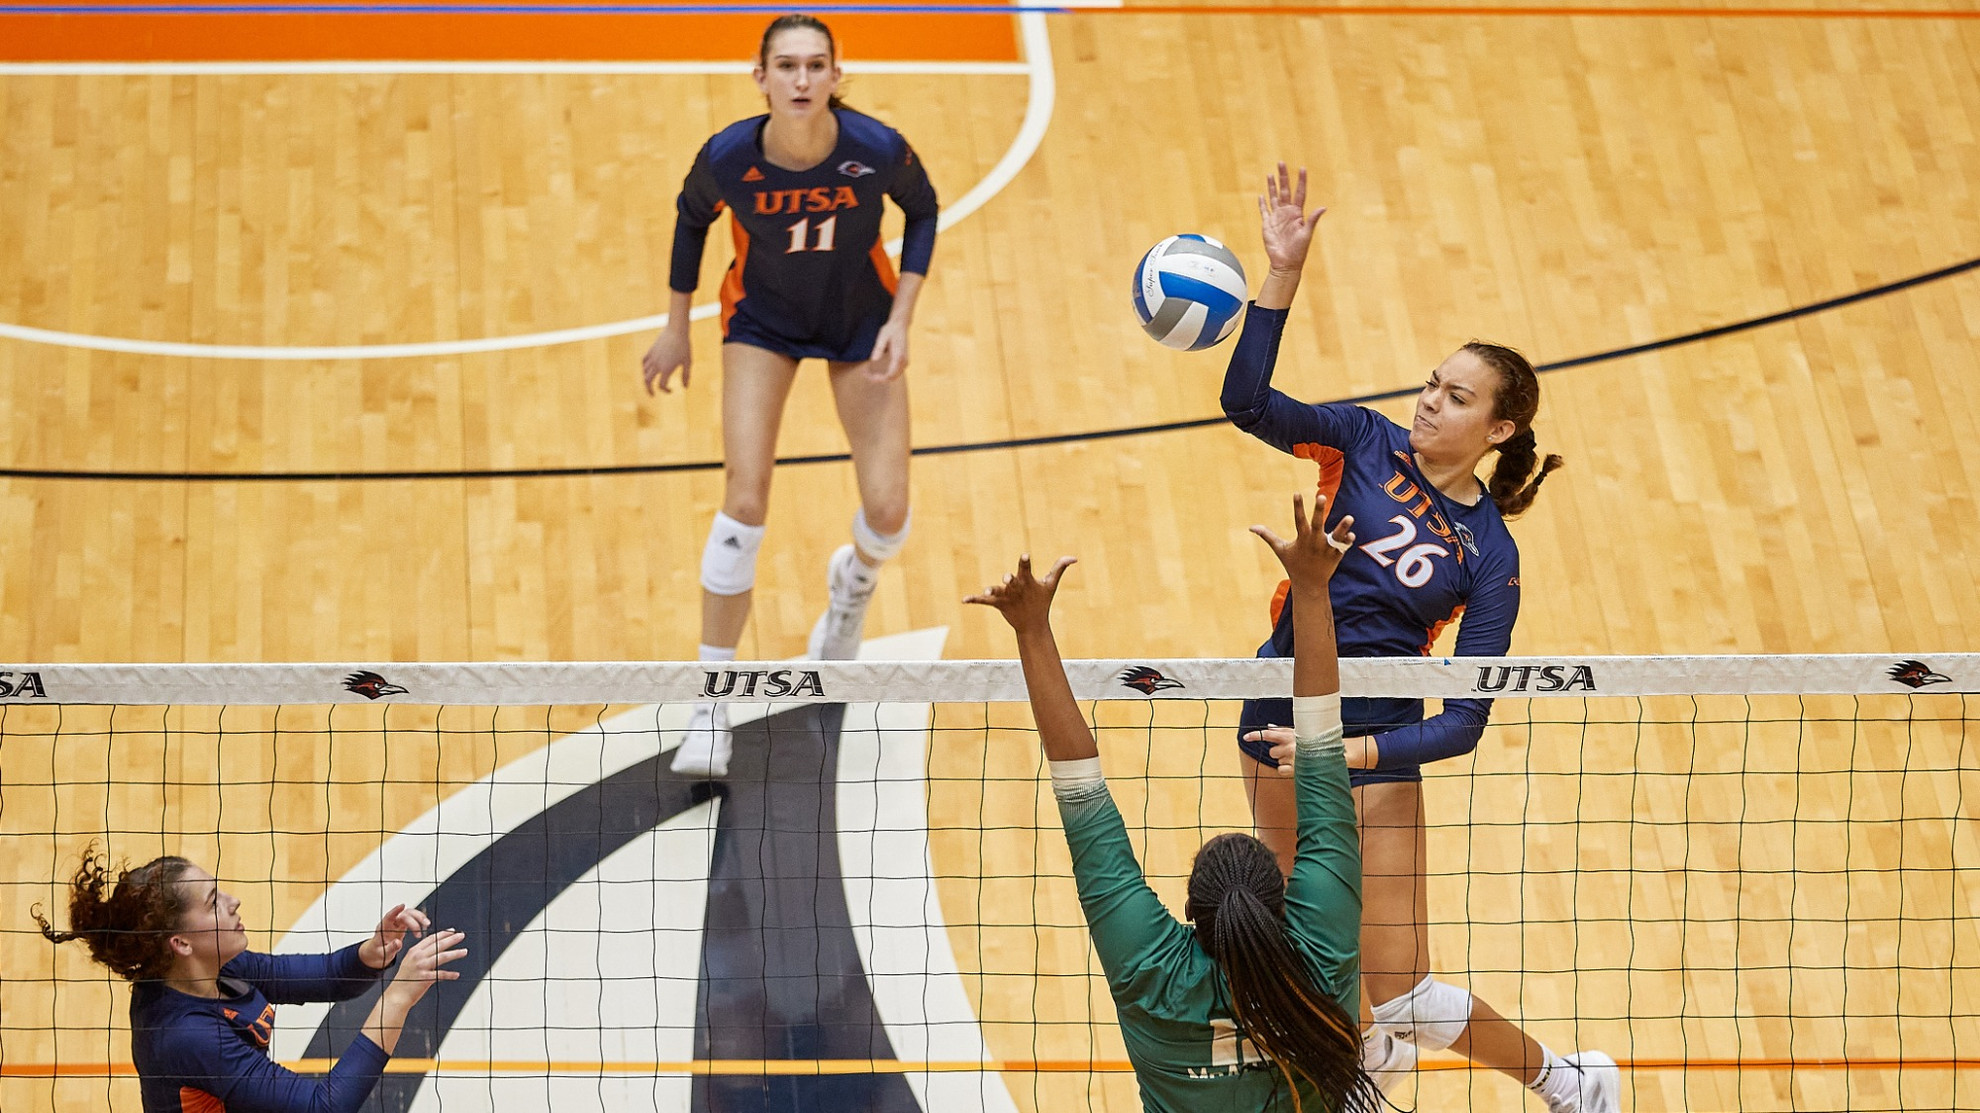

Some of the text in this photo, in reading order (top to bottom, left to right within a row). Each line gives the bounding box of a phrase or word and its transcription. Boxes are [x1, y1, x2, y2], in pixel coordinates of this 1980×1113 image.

[754, 186, 860, 215] UTSA
[785, 214, 838, 254] 11
[1358, 514, 1450, 589] 26
[703, 670, 826, 697] UTSA
[1476, 665, 1597, 692] UTSA
